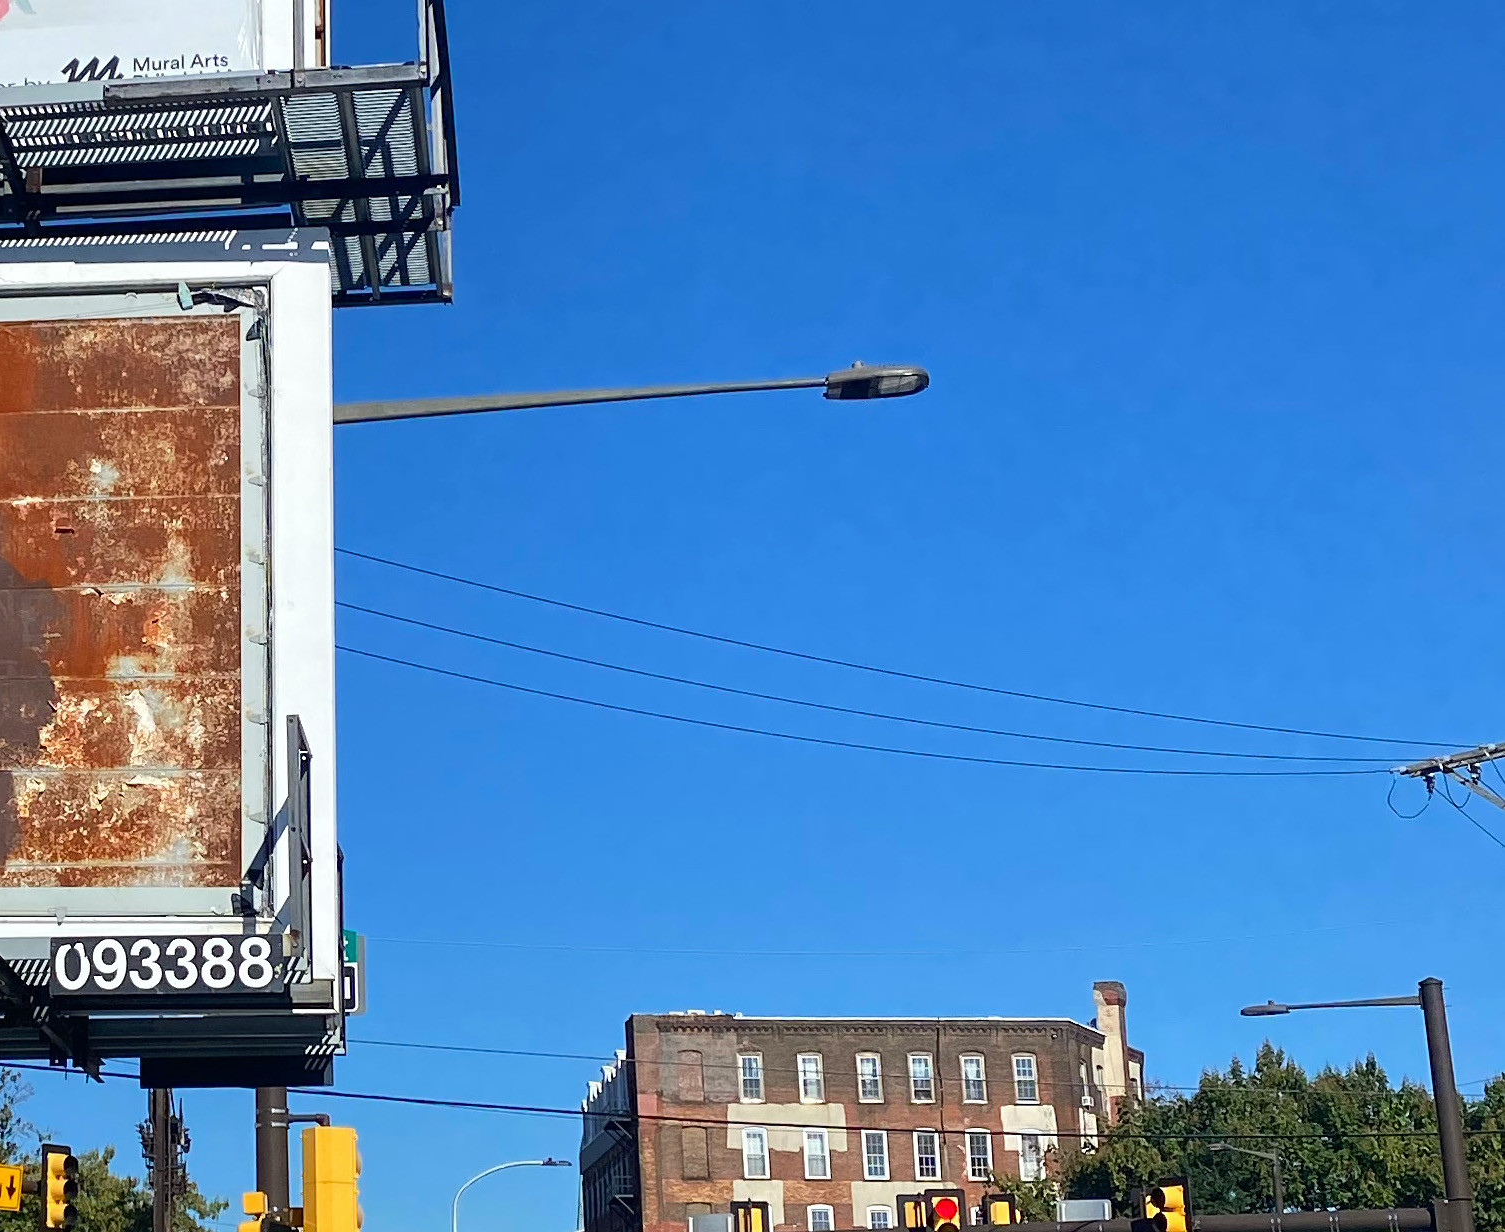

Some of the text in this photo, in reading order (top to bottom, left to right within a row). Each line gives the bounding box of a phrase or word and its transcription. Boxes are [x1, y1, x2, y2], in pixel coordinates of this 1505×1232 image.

[133, 53, 229, 72] Mural Arts
[54, 936, 274, 991] 093388
